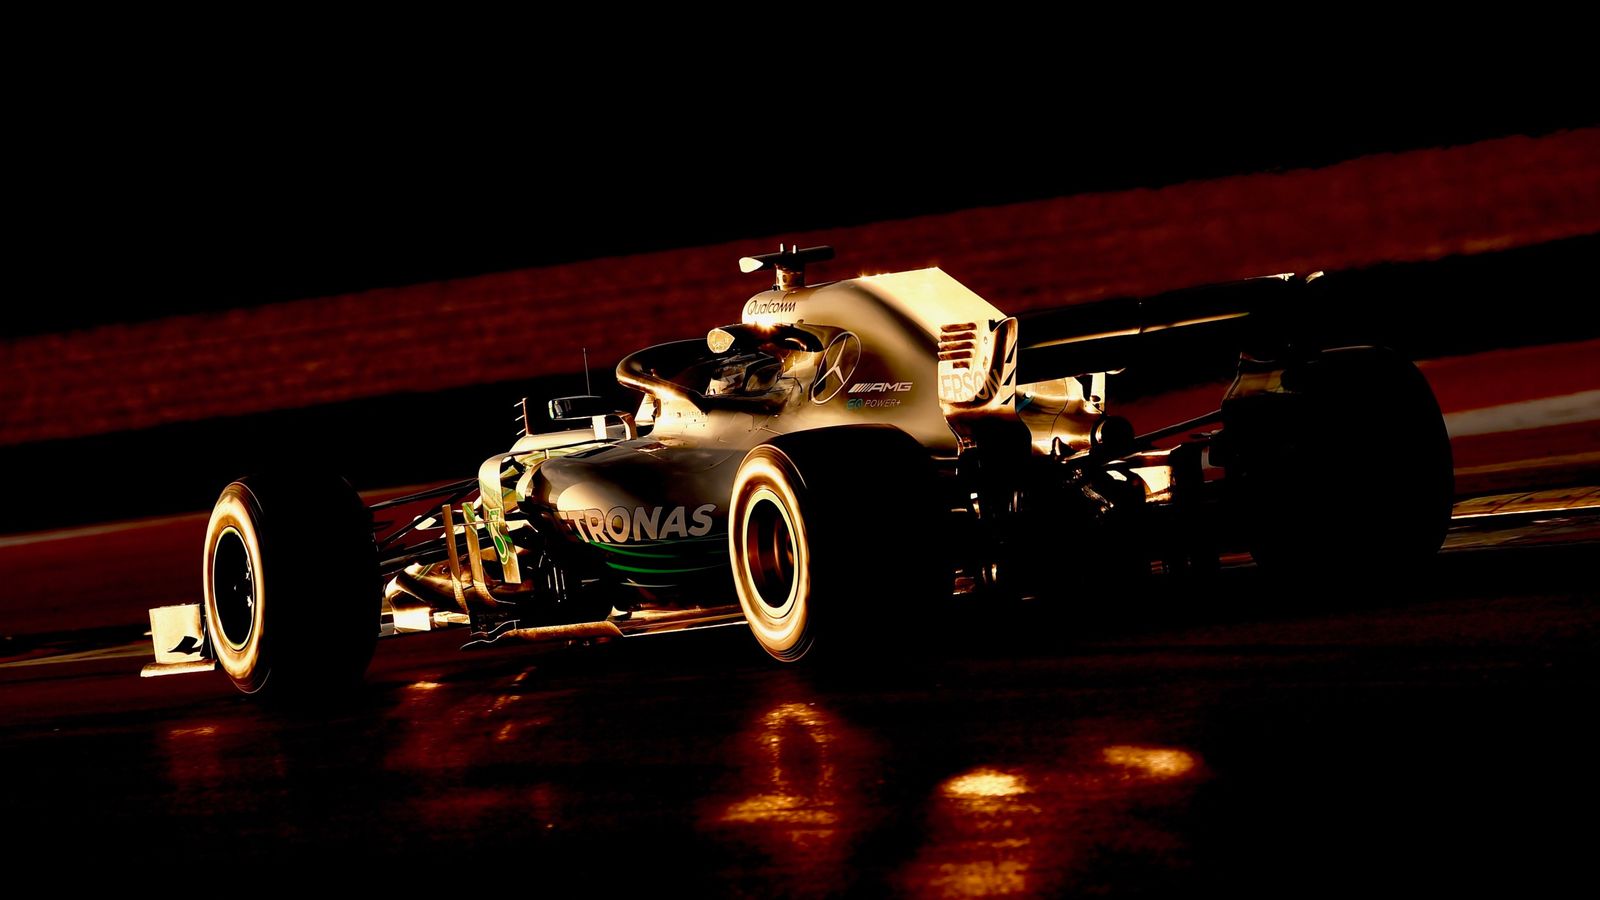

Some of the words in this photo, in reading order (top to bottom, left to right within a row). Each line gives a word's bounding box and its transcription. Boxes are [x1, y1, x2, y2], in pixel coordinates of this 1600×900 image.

[747, 299, 796, 316] Qualcomm
[865, 399, 901, 408] POWER+
[558, 503, 717, 543] TRONAS
